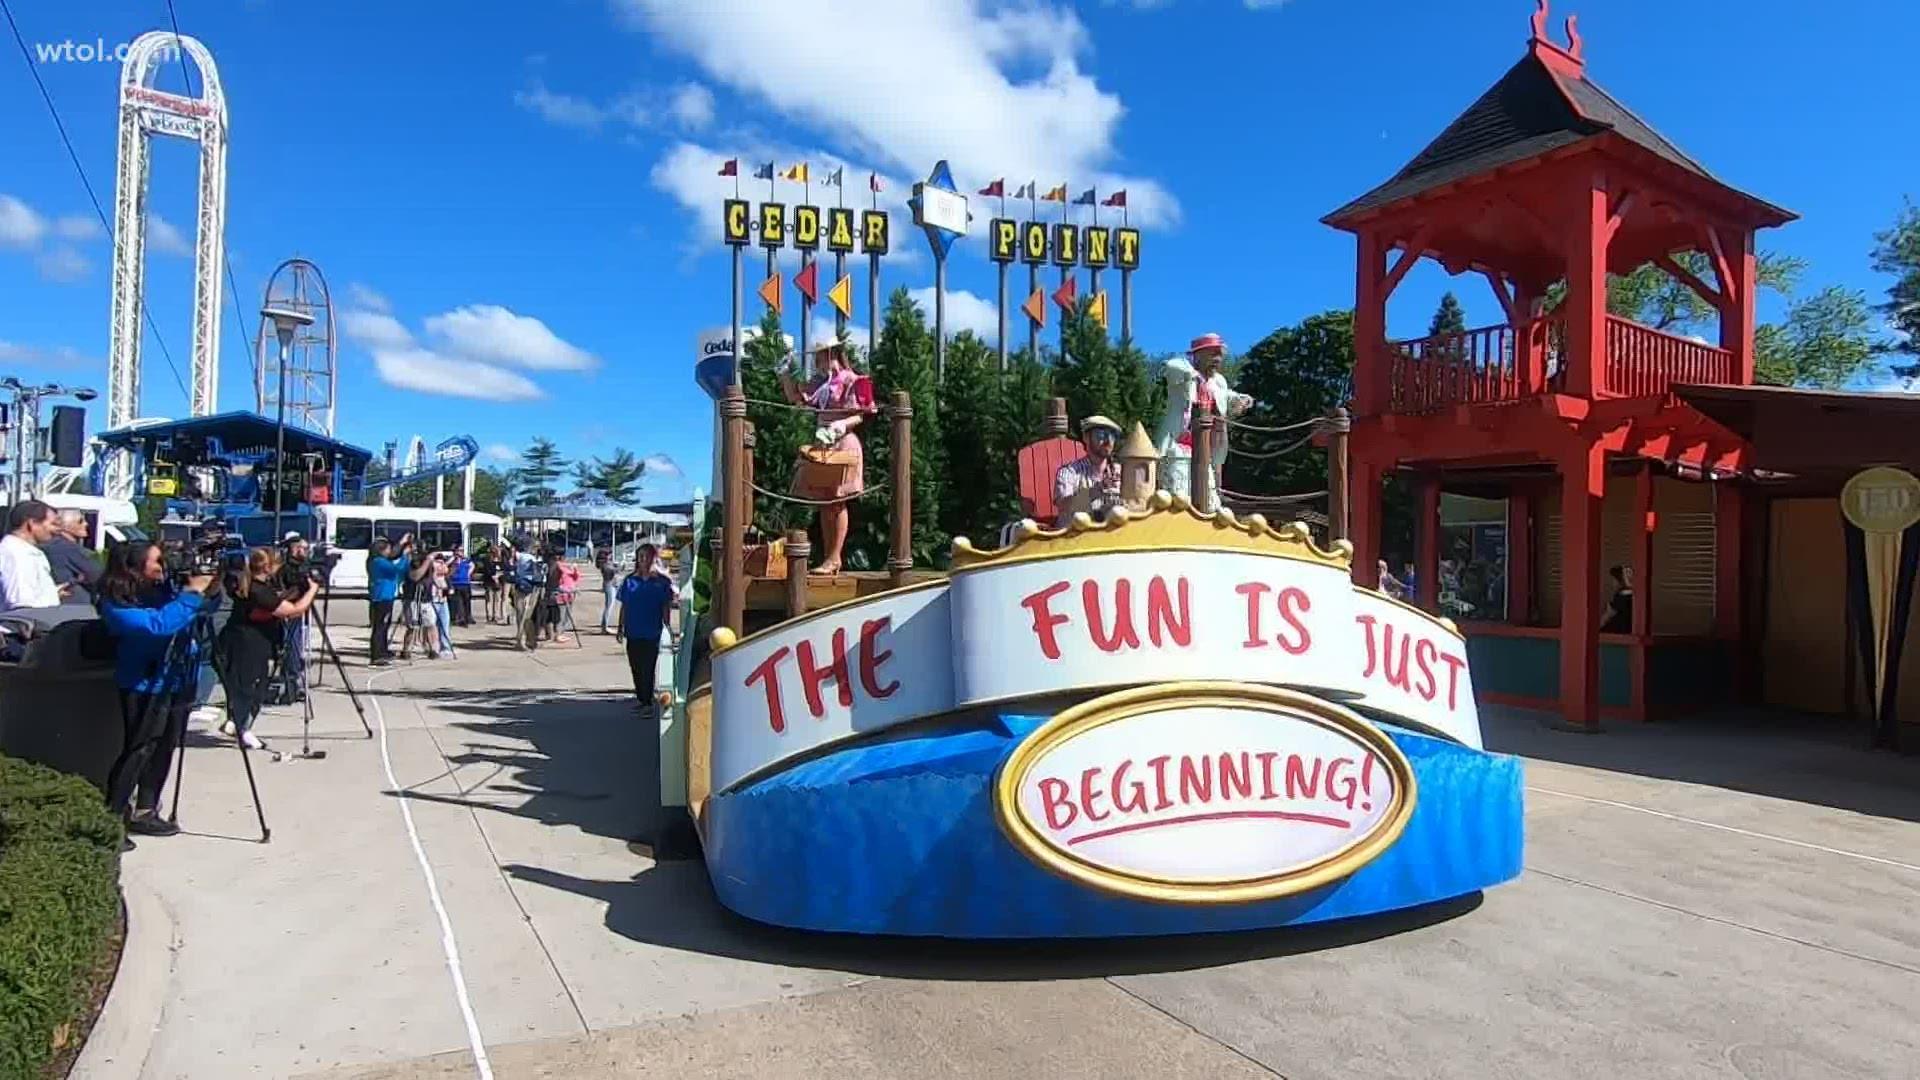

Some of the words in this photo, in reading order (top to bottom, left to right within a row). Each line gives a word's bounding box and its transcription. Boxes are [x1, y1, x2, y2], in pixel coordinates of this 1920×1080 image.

[728, 204, 886, 248] CEDAR
[999, 223, 1138, 263] POINT
[705, 339, 734, 354] Ceda
[744, 616, 900, 733] THE
[1021, 575, 1192, 660] FUN
[1235, 581, 1312, 656] IS
[1355, 615, 1466, 711] JUST
[1038, 752, 1376, 831] BEGINNING!
